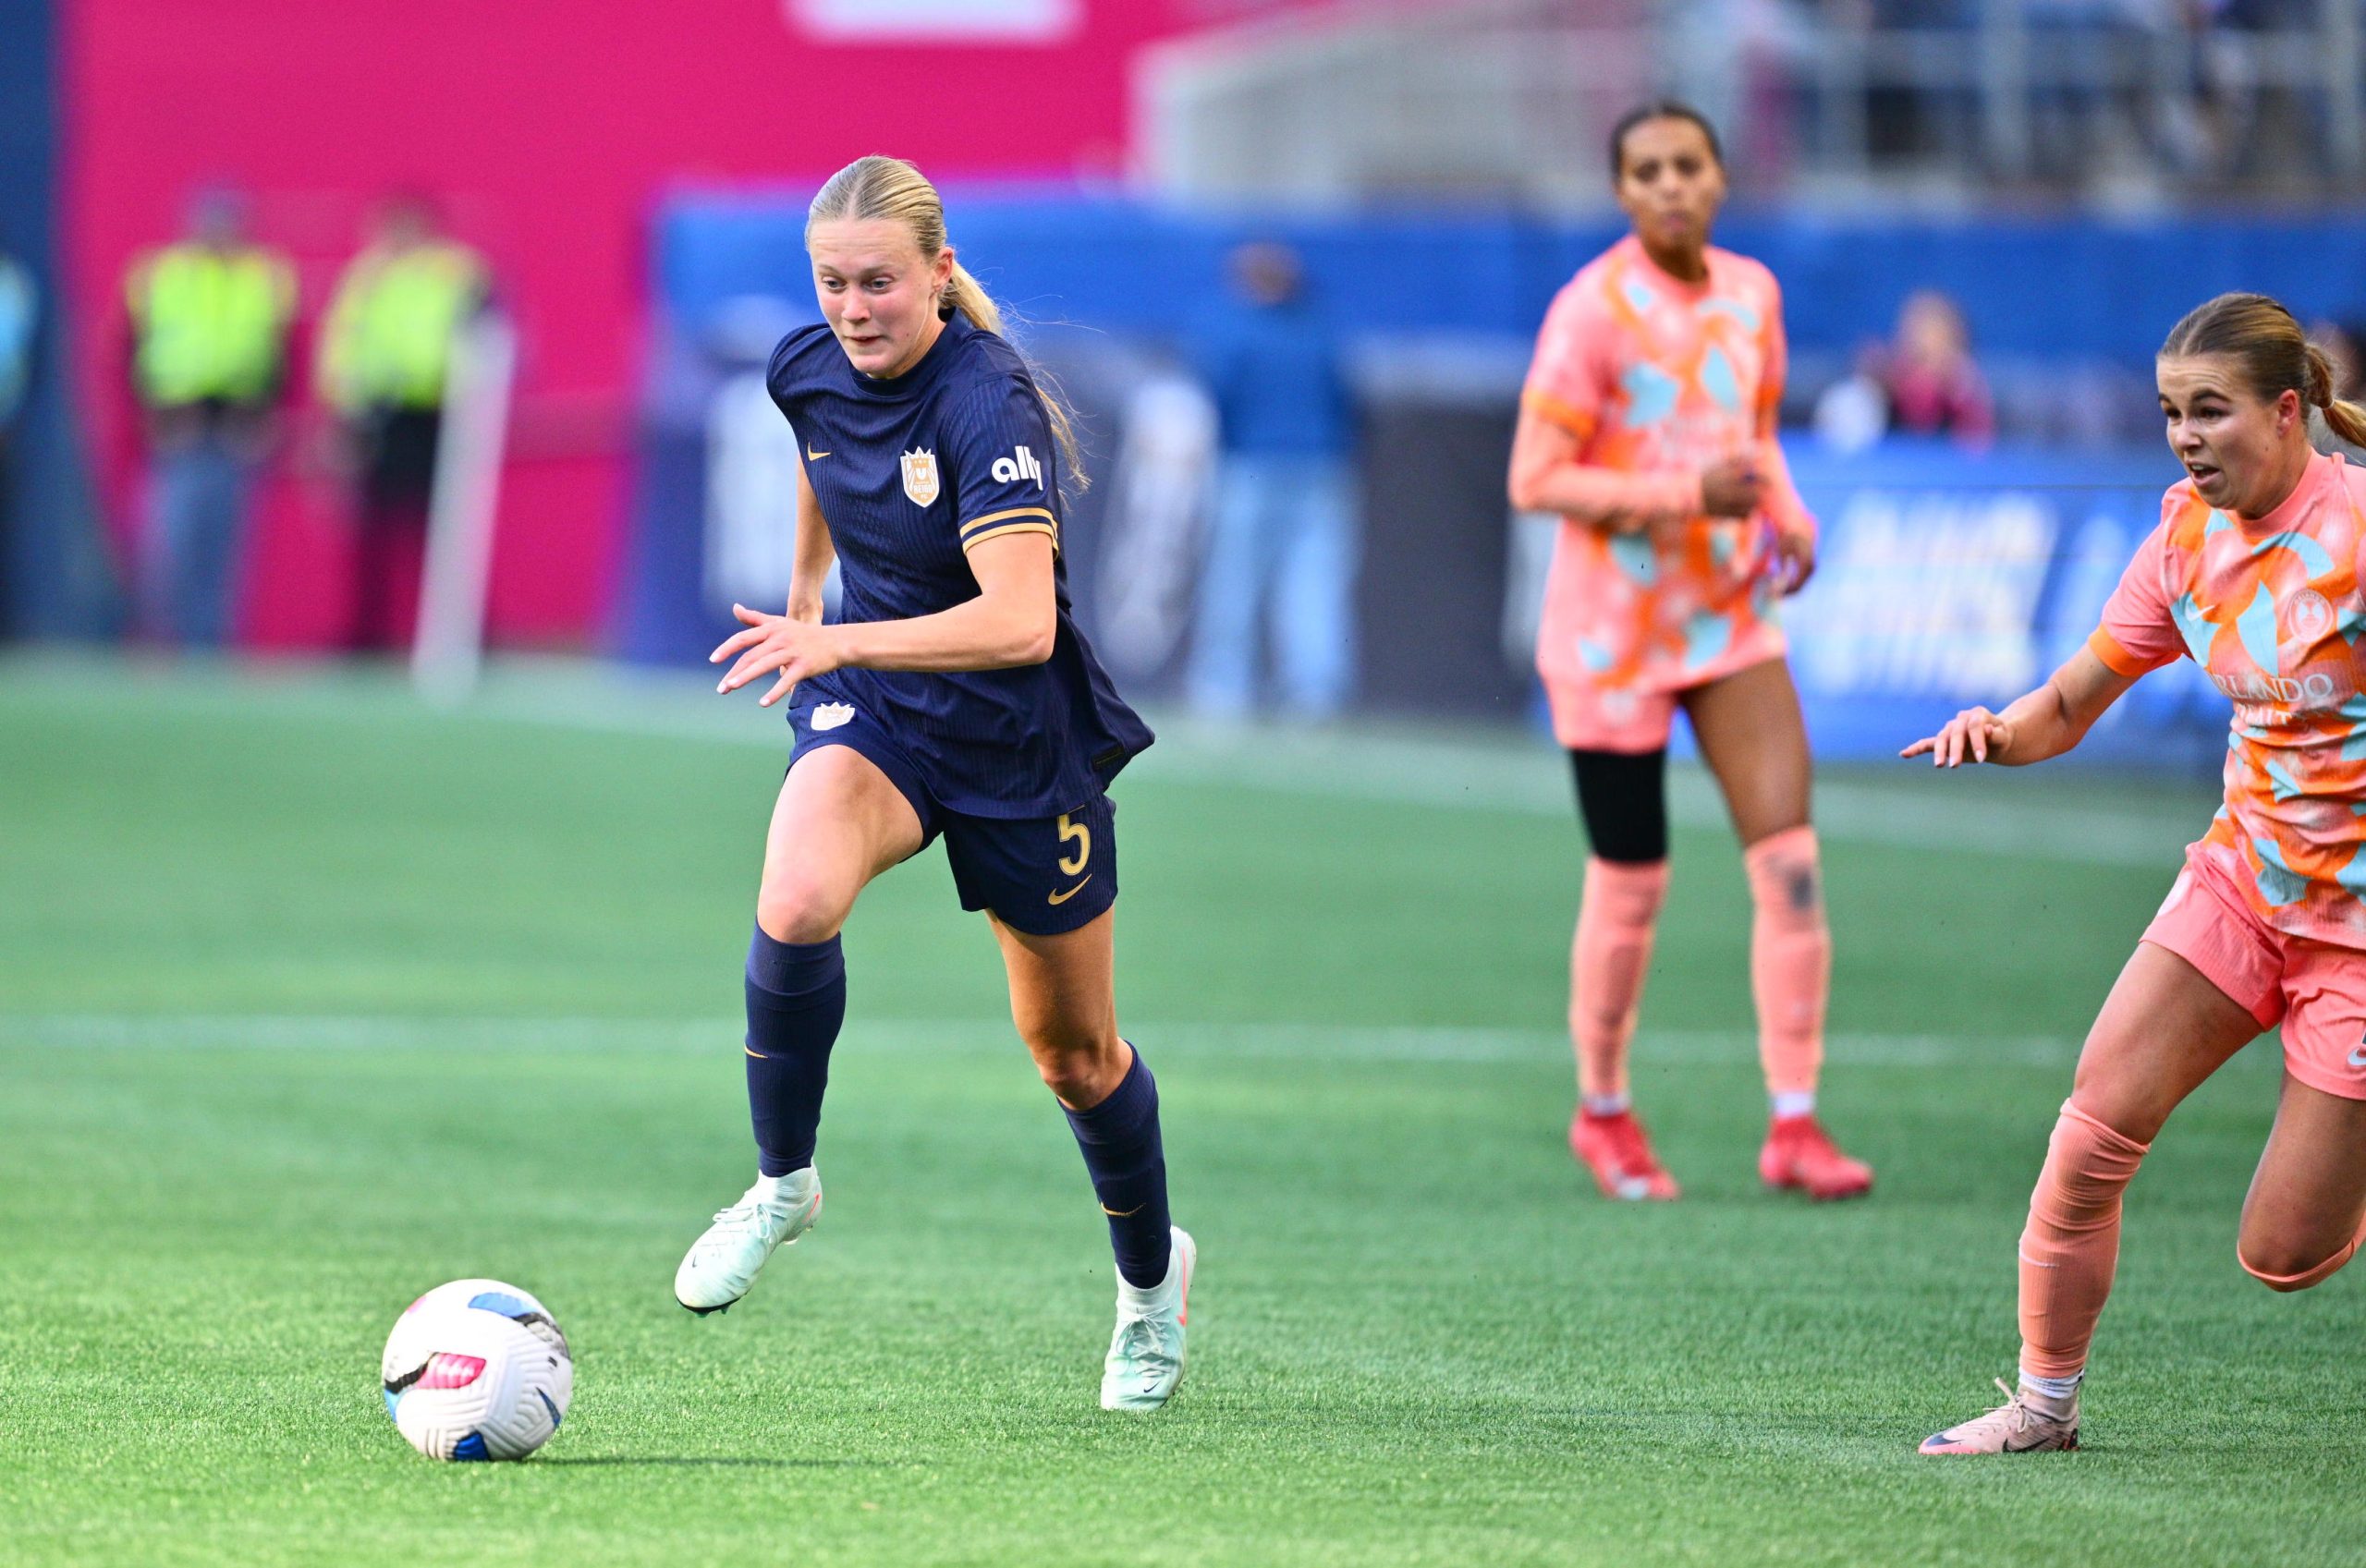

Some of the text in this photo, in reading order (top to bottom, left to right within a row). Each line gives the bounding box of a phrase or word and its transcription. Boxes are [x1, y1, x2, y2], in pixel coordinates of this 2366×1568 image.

[992, 445, 1043, 491] ally
[2210, 673, 2334, 703] RLANDO
[1056, 804, 1092, 877] 5
